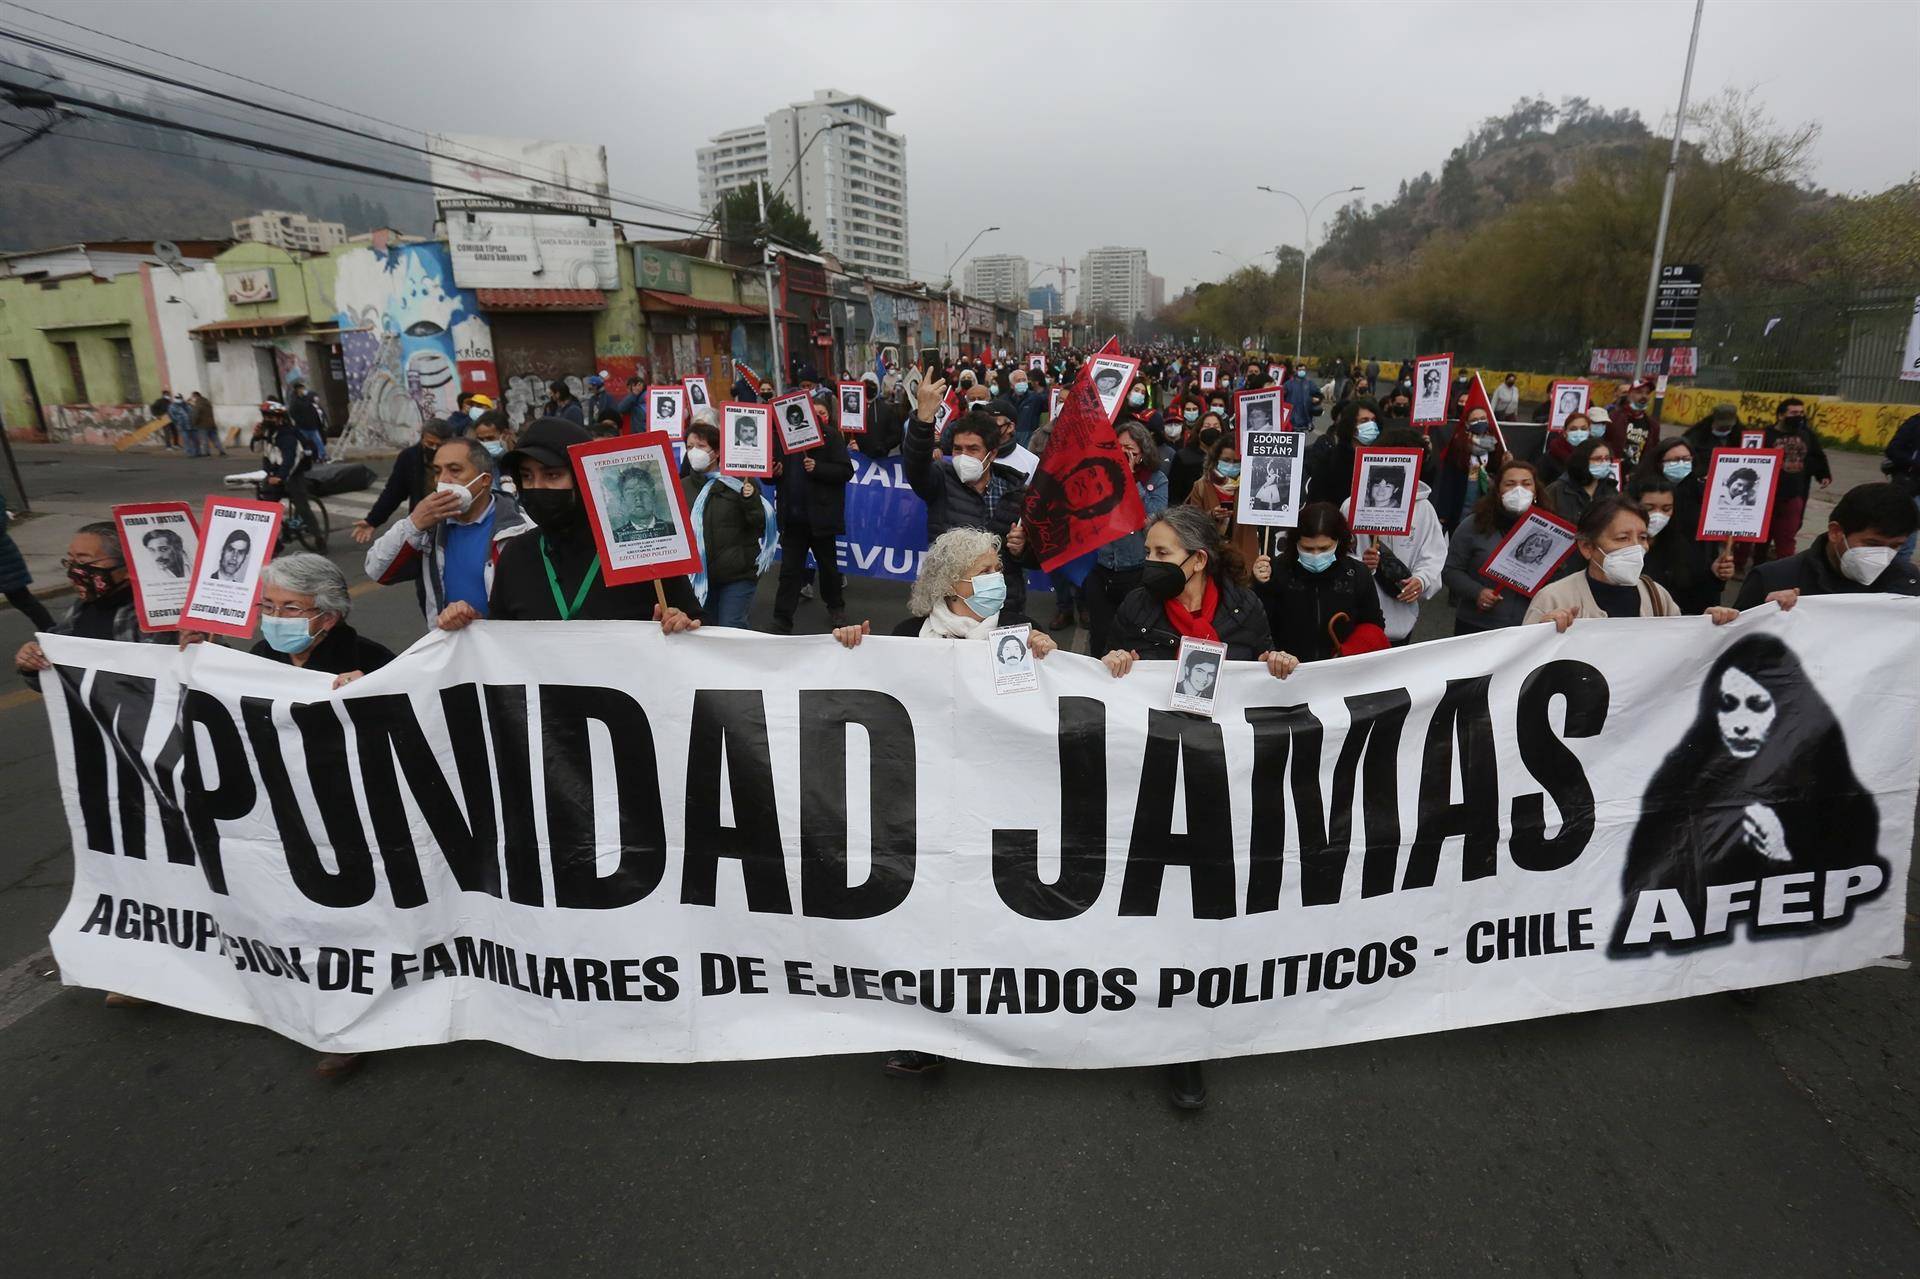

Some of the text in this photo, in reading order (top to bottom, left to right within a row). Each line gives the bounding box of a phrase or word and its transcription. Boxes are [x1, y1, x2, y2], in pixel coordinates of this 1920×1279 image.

[456, 244, 484, 252] COMIDA
[1253, 434, 1293, 444] ¿DÓNDE
[1253, 445, 1293, 455] ESTÁN?
[593, 457, 620, 466] VERDAD
[625, 453, 654, 462] JUSTICIA
[214, 508, 236, 518] VERDAD
[244, 512, 270, 523] JUSTICIA
[52, 659, 1610, 920] IMPUNIDAD JAMAS
[1623, 864, 1885, 945] AFEP
[317, 946, 374, 994] DE
[391, 936, 678, 1002] FAMILIARES
[700, 952, 768, 997] DE
[784, 960, 1137, 1014] EJECUTADOS
[1158, 935, 1418, 1008] POLITICOS
[1466, 907, 1595, 964] CHILE
